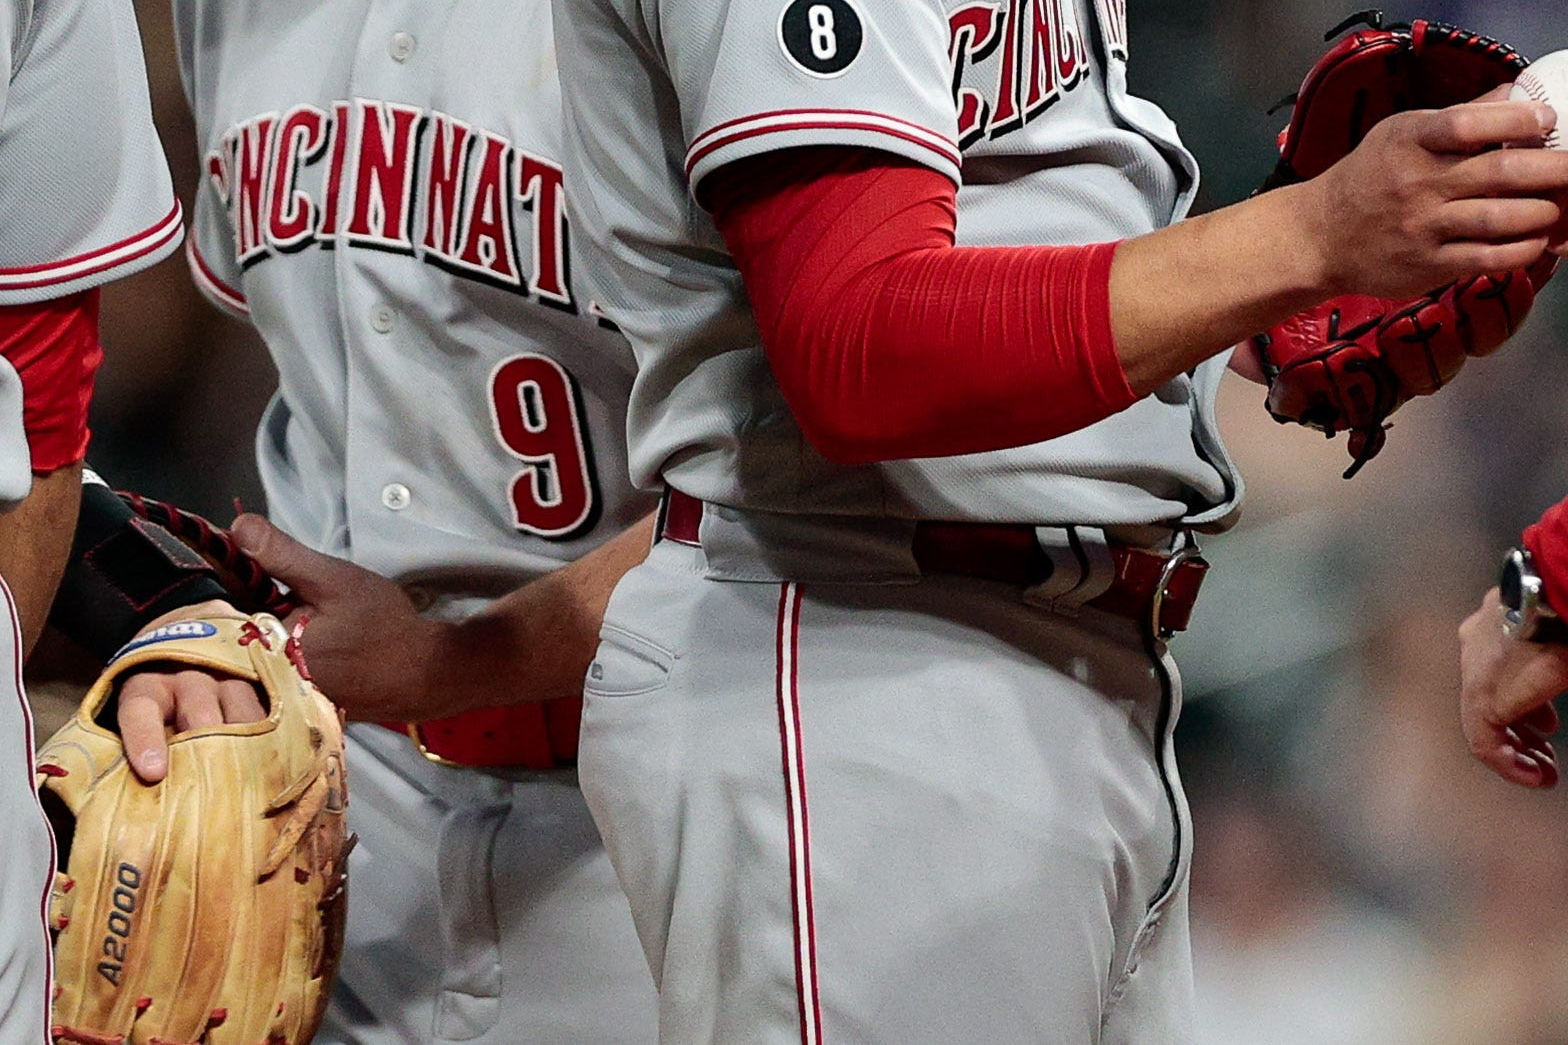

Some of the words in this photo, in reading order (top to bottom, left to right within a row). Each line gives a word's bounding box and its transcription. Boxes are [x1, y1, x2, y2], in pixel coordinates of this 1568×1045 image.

[807, 4, 837, 60] 8
[487, 353, 598, 540] 9
[97, 861, 142, 987] A2000
